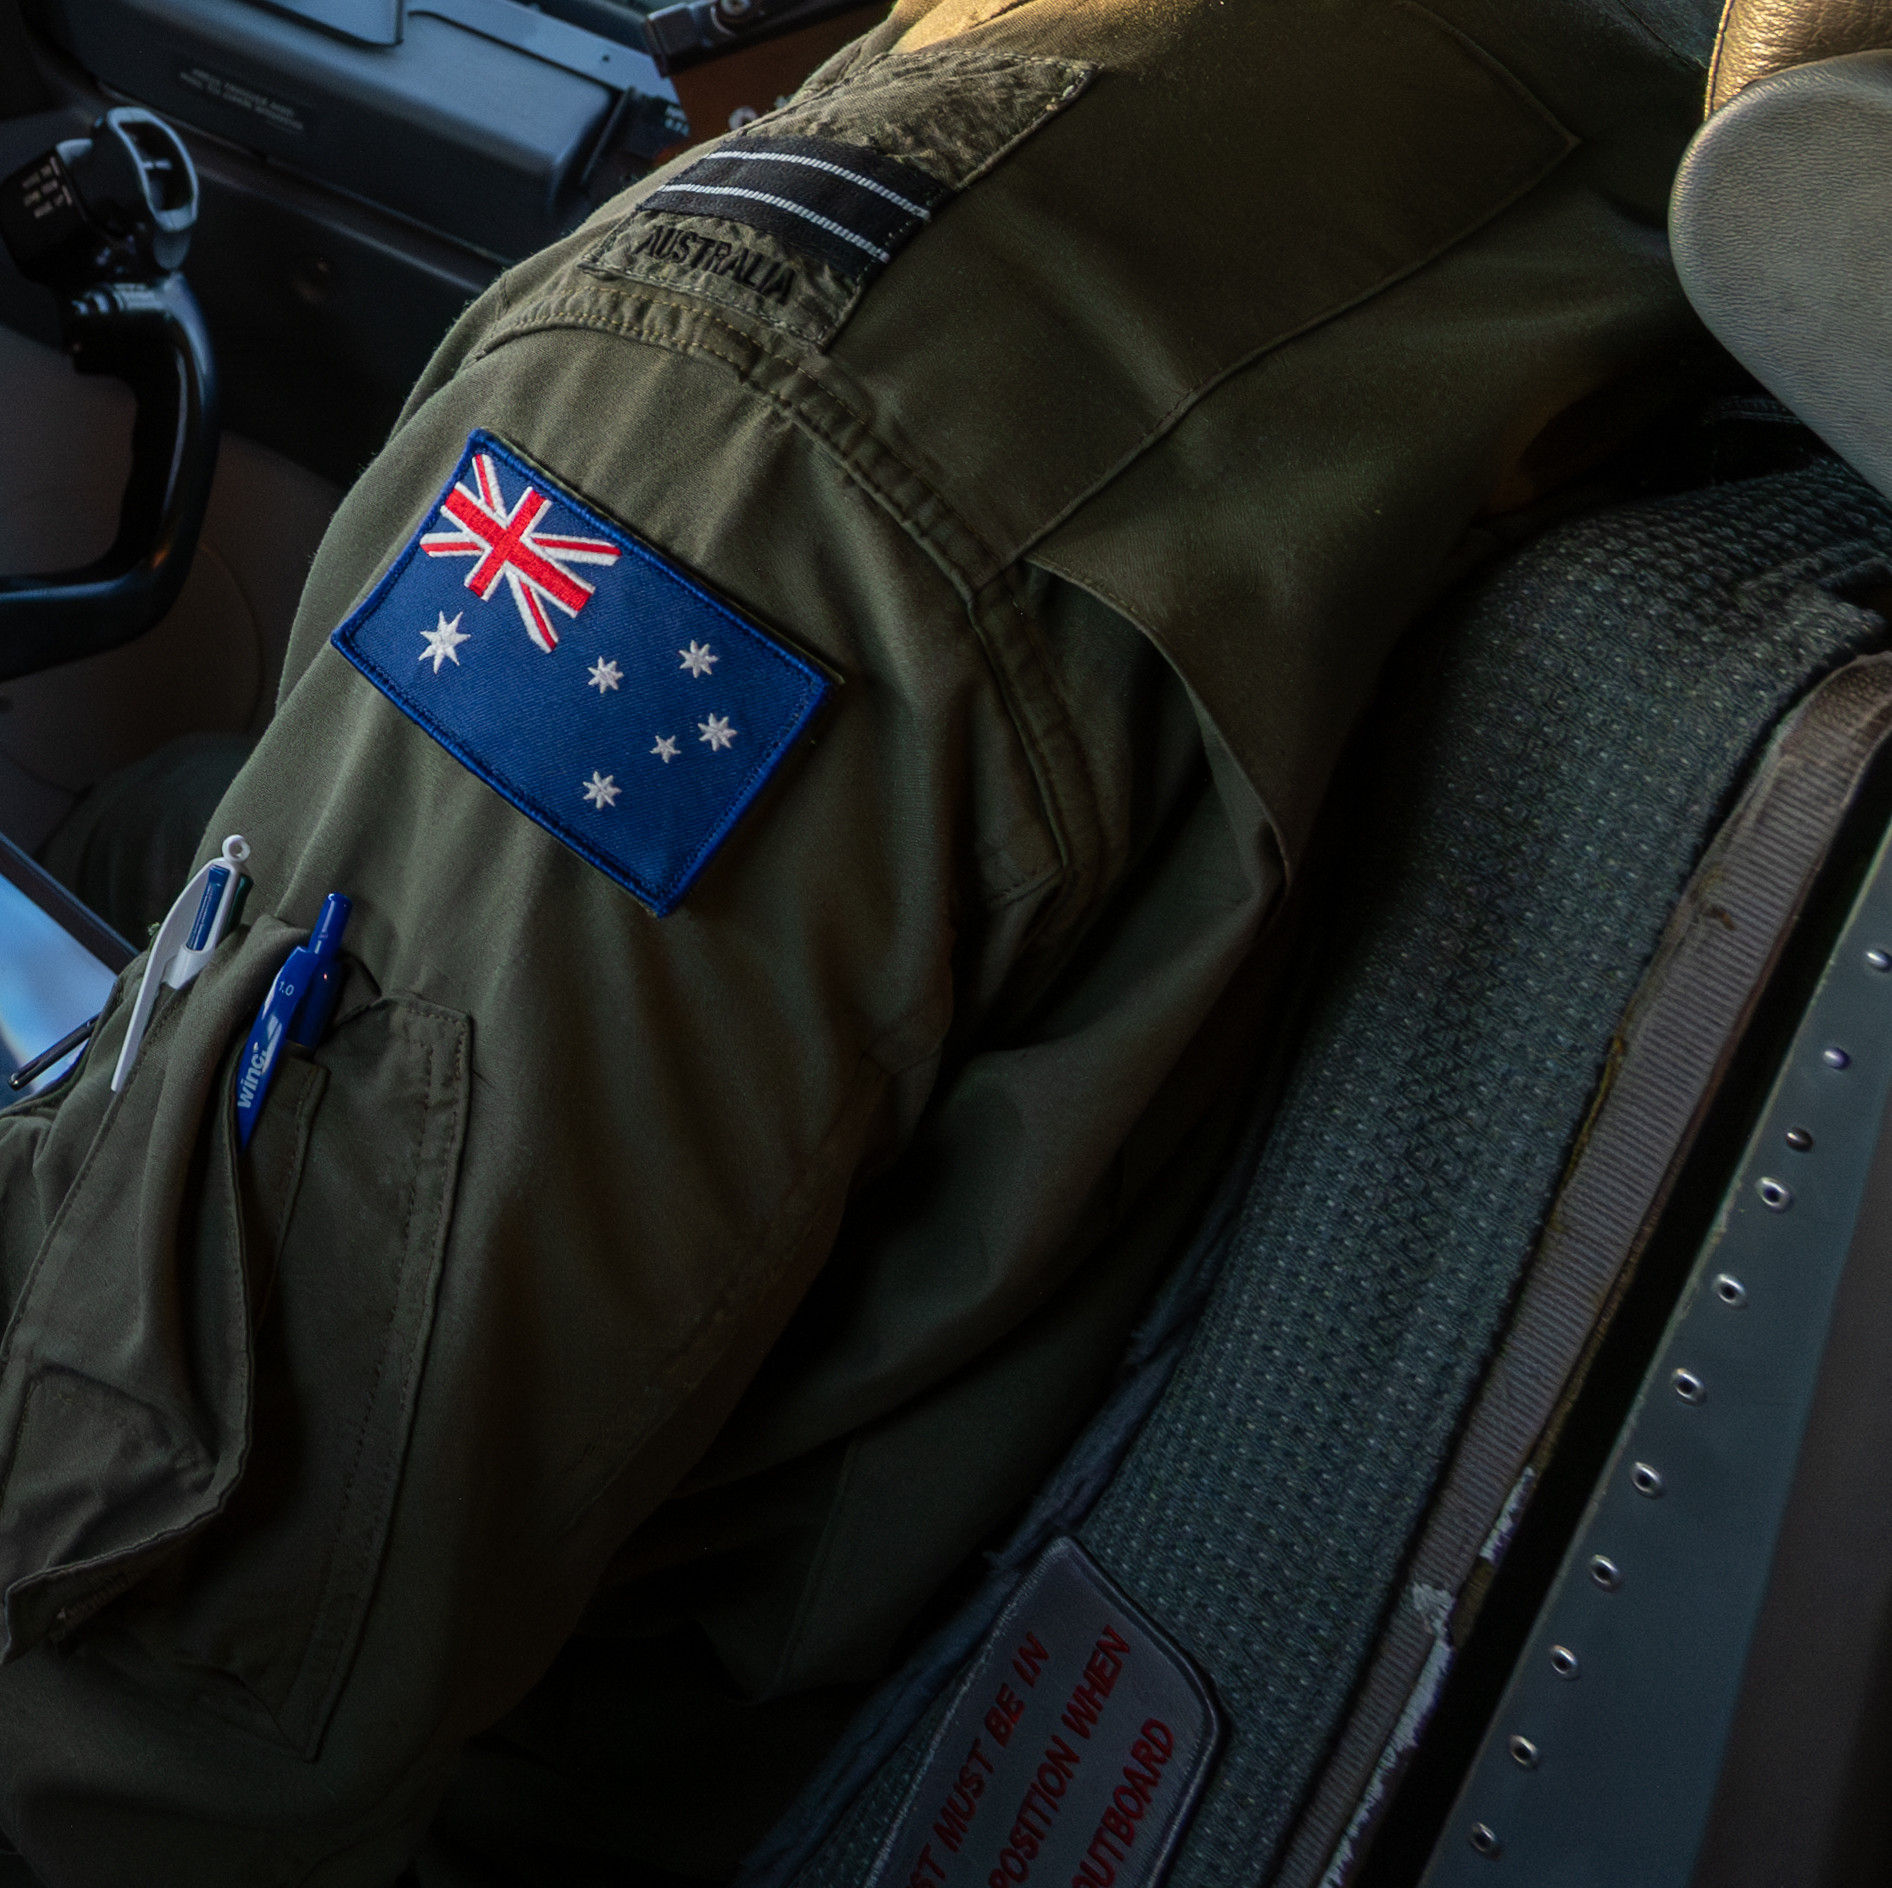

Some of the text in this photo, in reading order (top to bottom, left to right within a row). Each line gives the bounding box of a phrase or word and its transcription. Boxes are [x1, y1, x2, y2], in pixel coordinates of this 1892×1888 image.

[637, 225, 797, 306] AUSTRALIA
[279, 981, 294, 996] 1.0
[933, 1631, 1050, 1852] MUST BE IN
[988, 1624, 1130, 1888] POSITION WHEN
